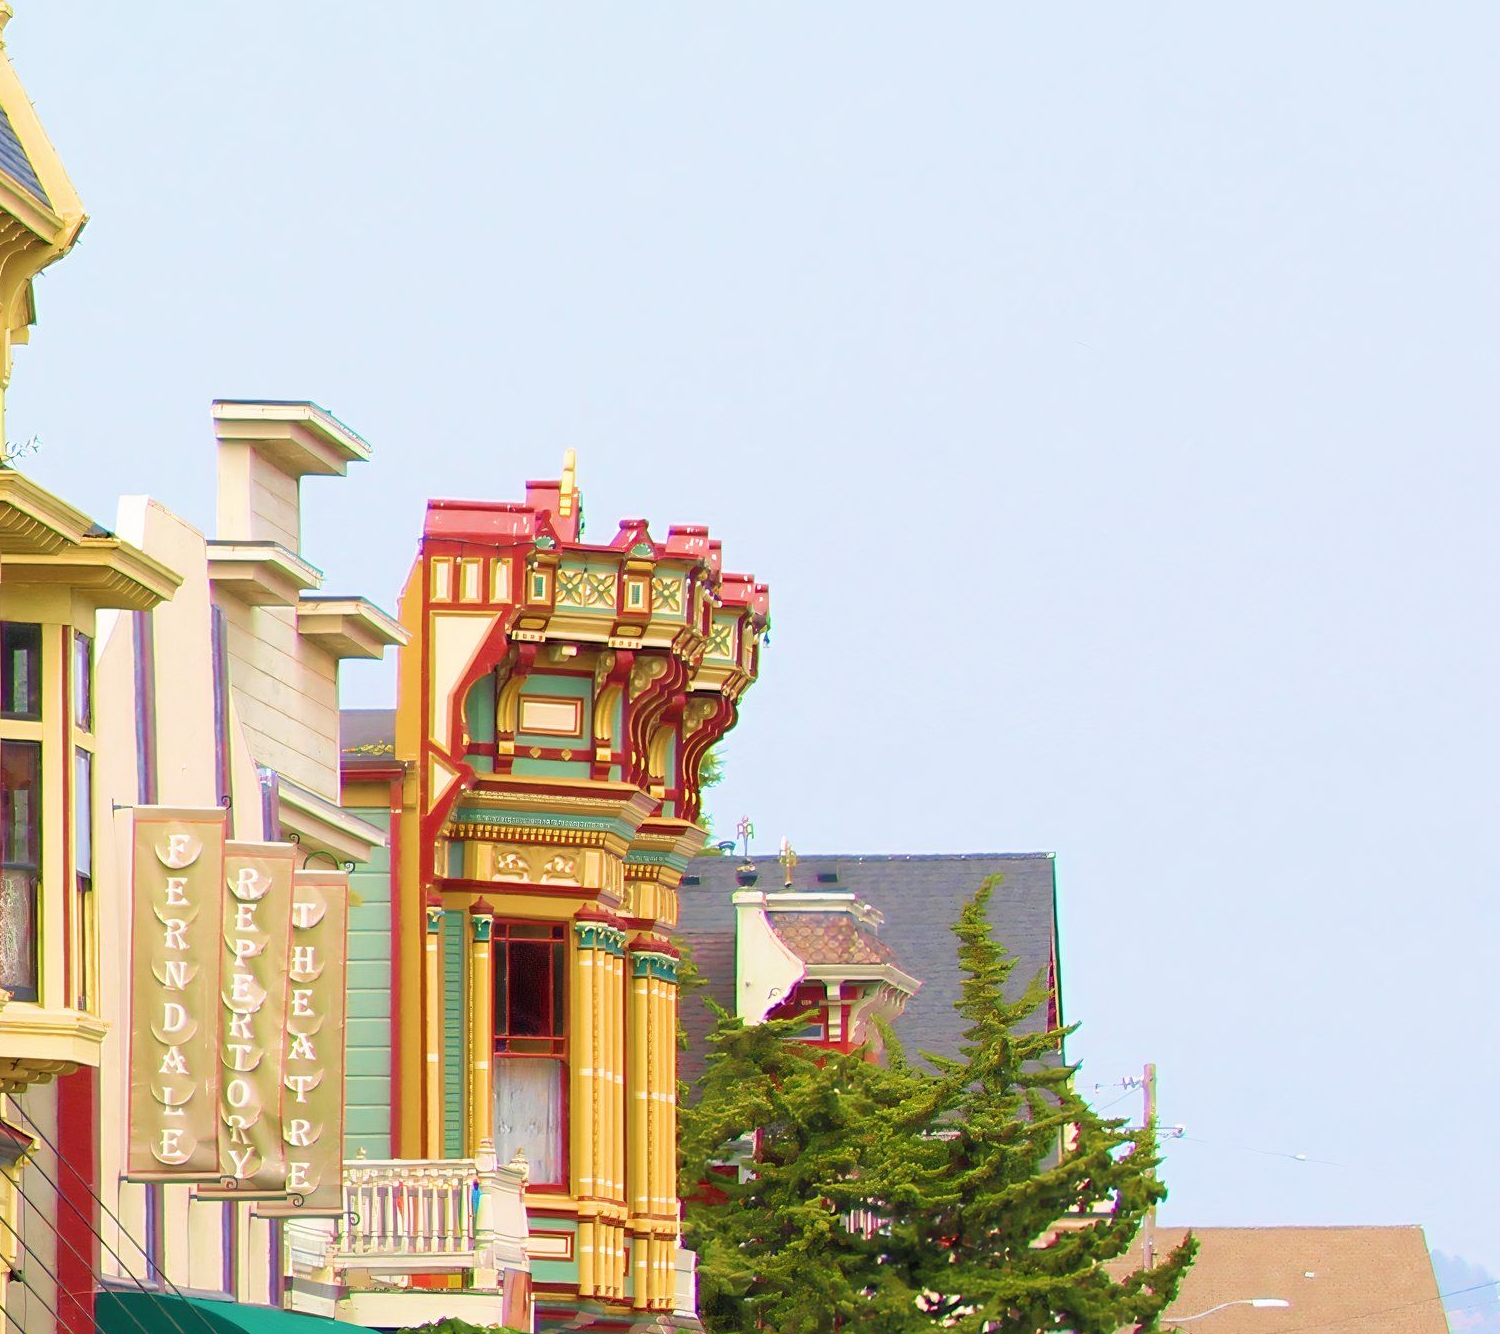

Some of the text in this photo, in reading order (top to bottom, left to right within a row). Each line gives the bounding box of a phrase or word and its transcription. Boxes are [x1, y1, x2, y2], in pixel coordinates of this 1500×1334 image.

[158, 834, 191, 1157] FERNDALE
[226, 867, 263, 1179] REPERTORY
[287, 901, 318, 1189] THEATRE
